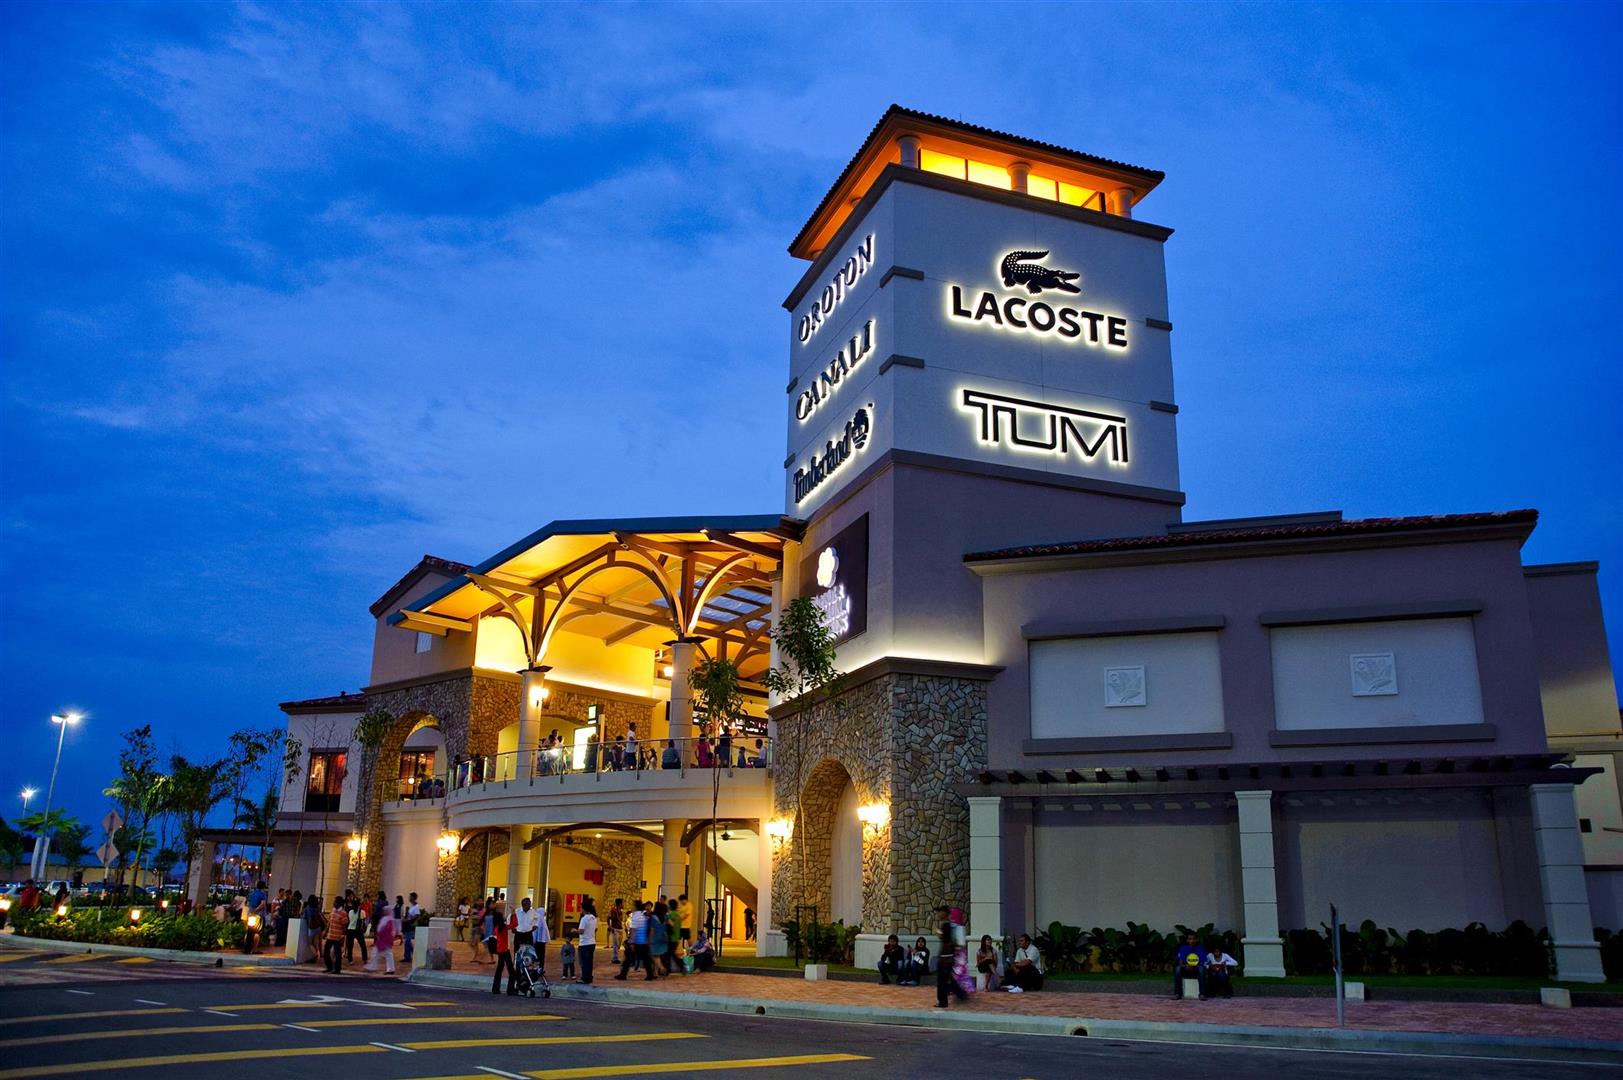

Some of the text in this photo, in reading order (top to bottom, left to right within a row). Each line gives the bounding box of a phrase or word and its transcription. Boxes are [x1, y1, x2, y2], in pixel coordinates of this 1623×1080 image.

[799, 234, 873, 343] OROTON
[952, 285, 1128, 347] LACOSTE
[796, 320, 872, 420] CANALI
[793, 421, 852, 504] Timberland
[963, 389, 1129, 463] TUMI
